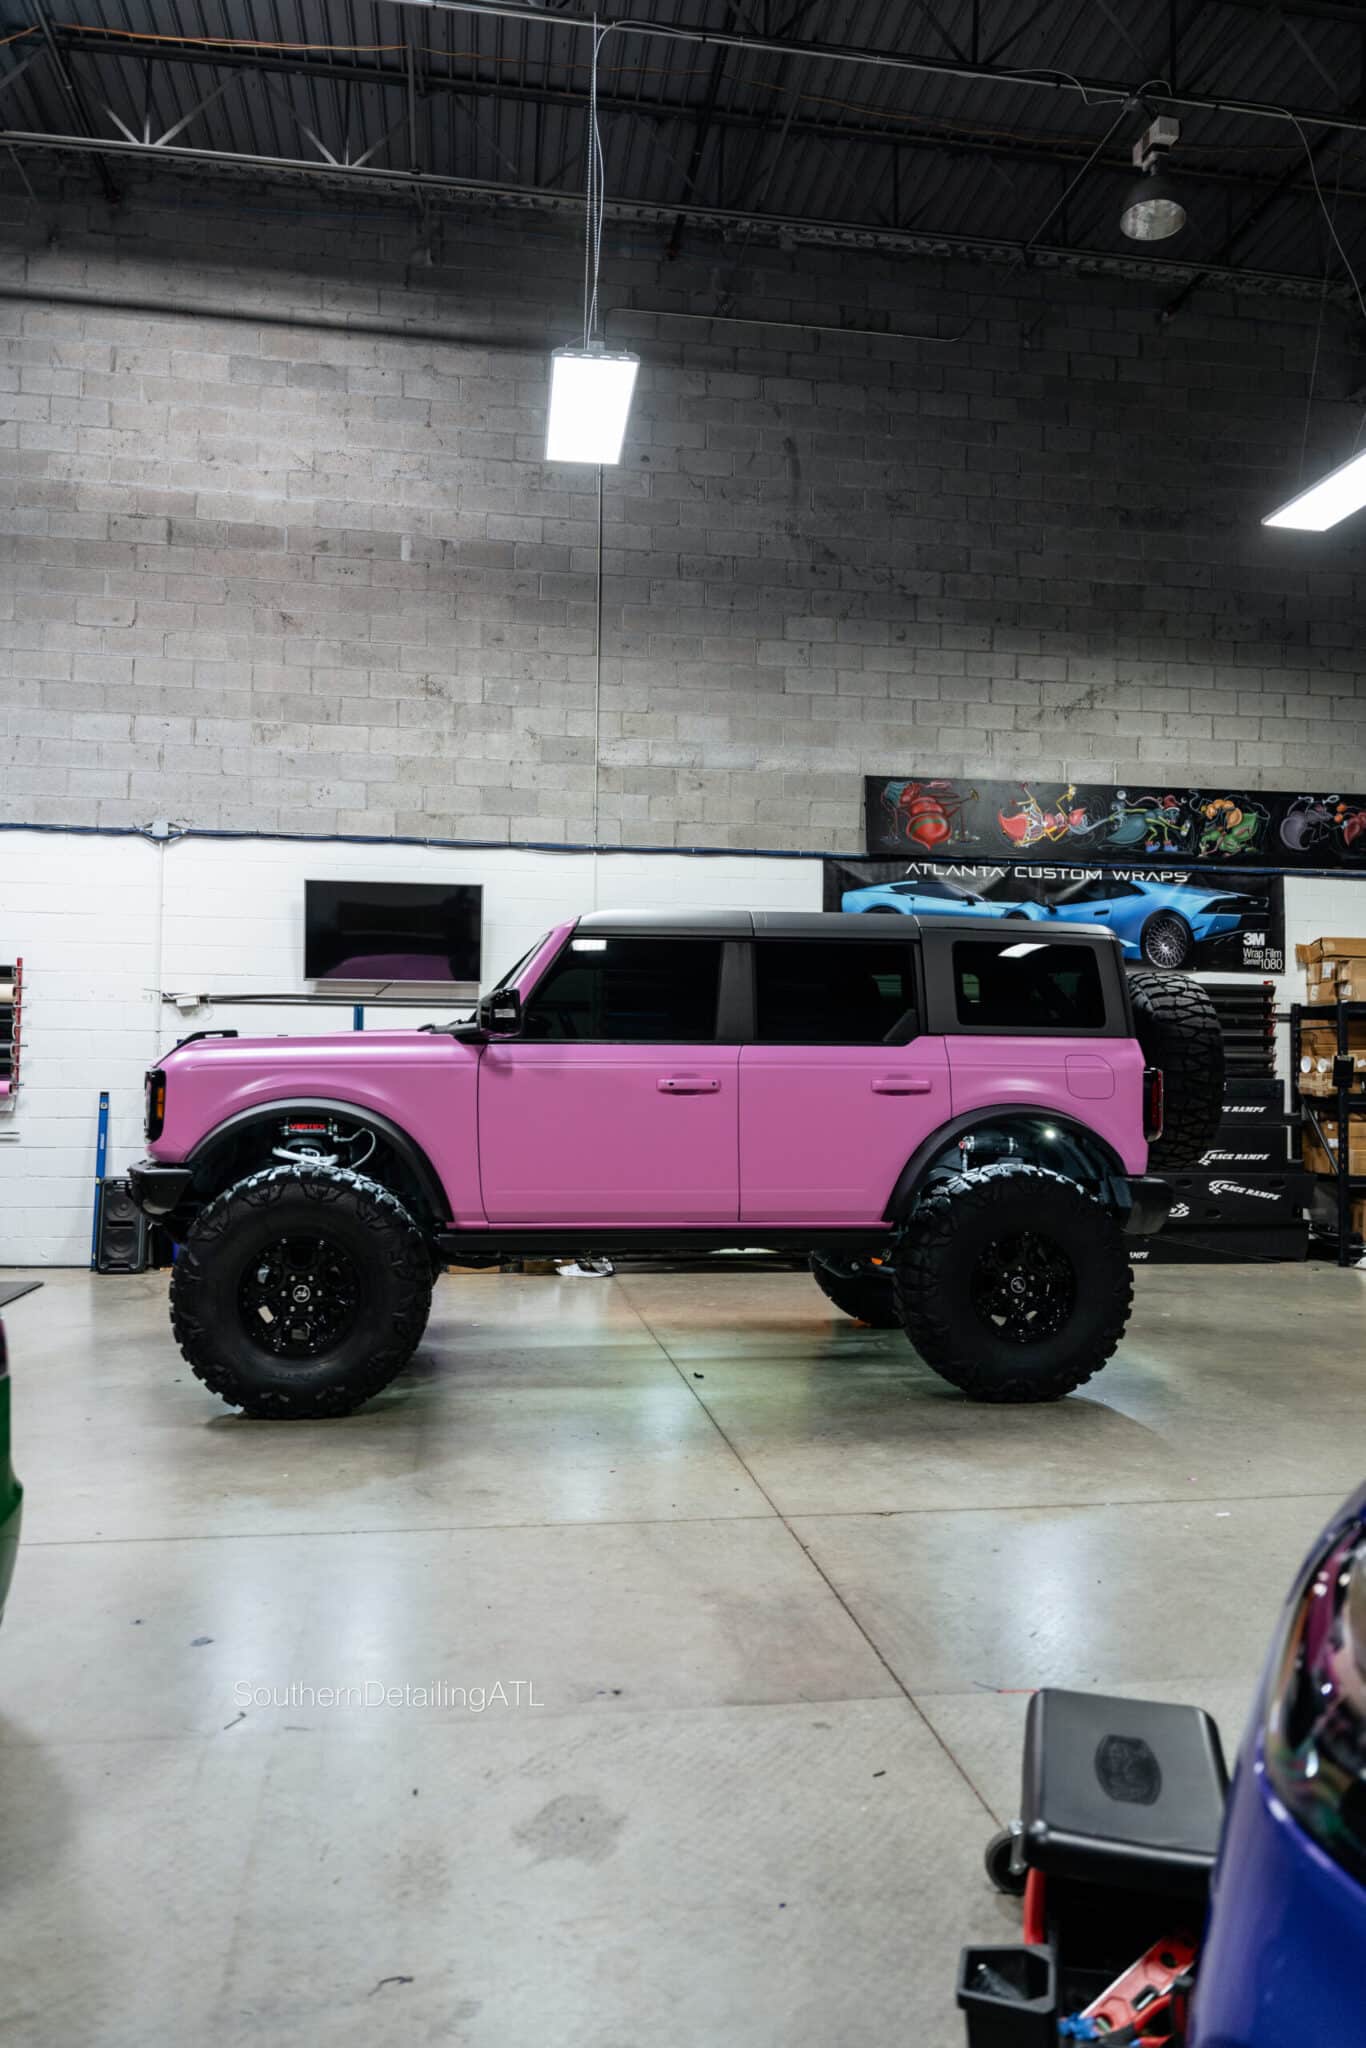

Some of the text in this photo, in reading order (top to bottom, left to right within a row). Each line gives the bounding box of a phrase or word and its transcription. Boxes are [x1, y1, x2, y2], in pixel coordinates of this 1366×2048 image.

[905, 863, 1190, 882] ATLANTA CUSTOM WRAPS
[1243, 932, 1265, 946] 3M
[1243, 947, 1282, 960] Wrap Film
[1260, 958, 1283, 970] 1080
[1231, 1105, 1267, 1113] RAMPS
[1221, 1184, 1281, 1201] RACE RAMPS
